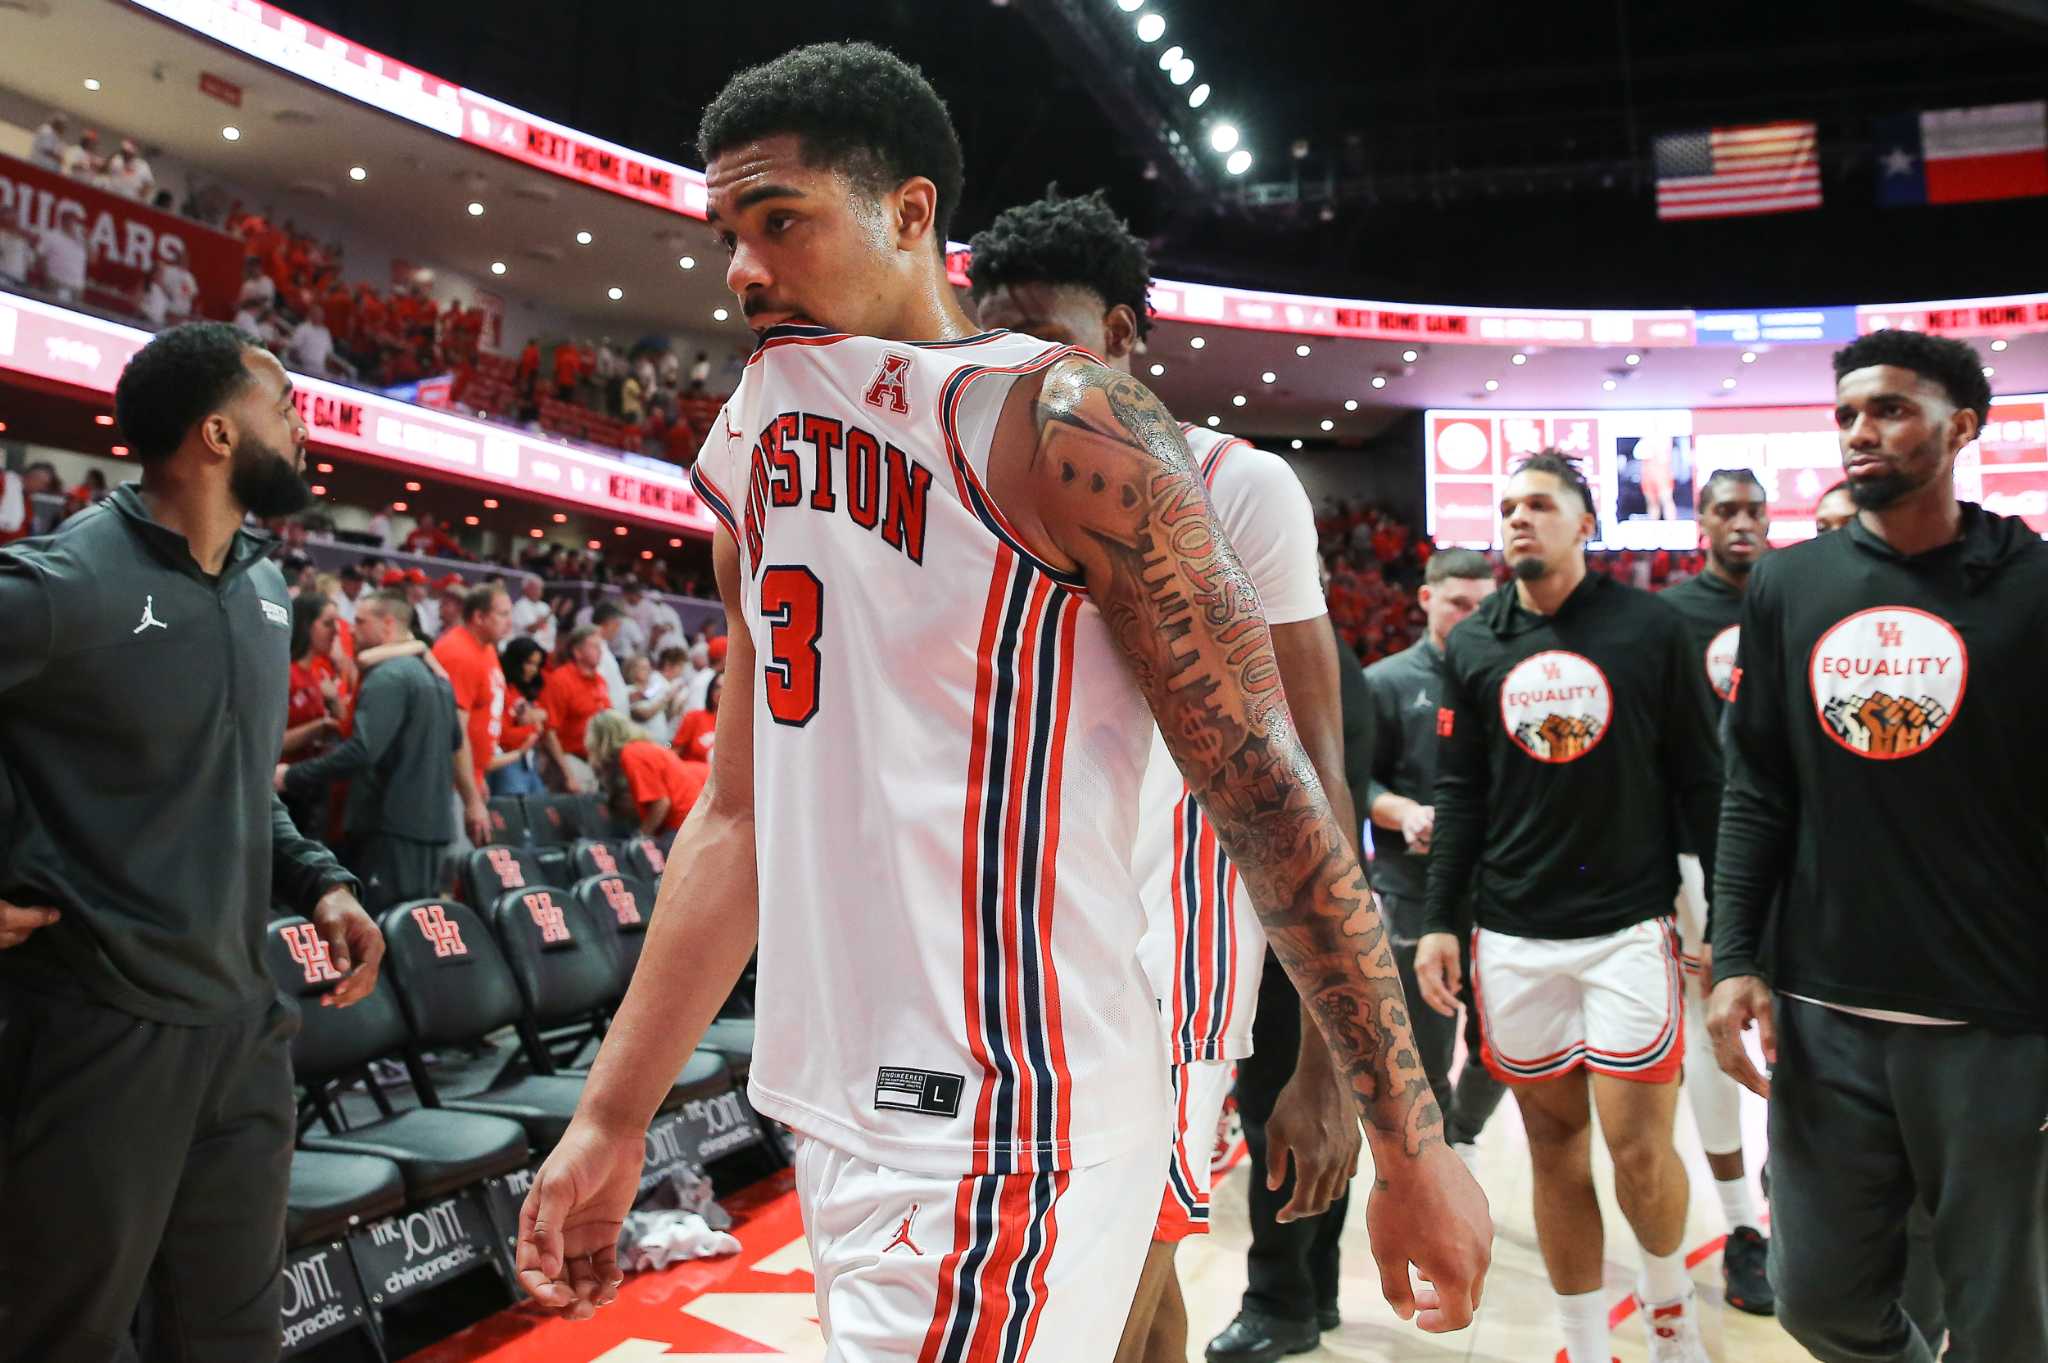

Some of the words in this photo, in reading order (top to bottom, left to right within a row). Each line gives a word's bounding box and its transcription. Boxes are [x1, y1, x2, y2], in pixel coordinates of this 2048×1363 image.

[760, 564, 824, 729] 3
[1822, 656, 1952, 679] EQUALITY
[1508, 686, 1598, 708] EQUALITY
[279, 923, 342, 984] UH
[411, 905, 468, 958] UH
[933, 1085, 944, 1103] L
[645, 1122, 683, 1167] OINT
[399, 1200, 465, 1262] JOINT
[280, 1252, 335, 1318] OINT
[384, 1243, 476, 1294] chiropractic
